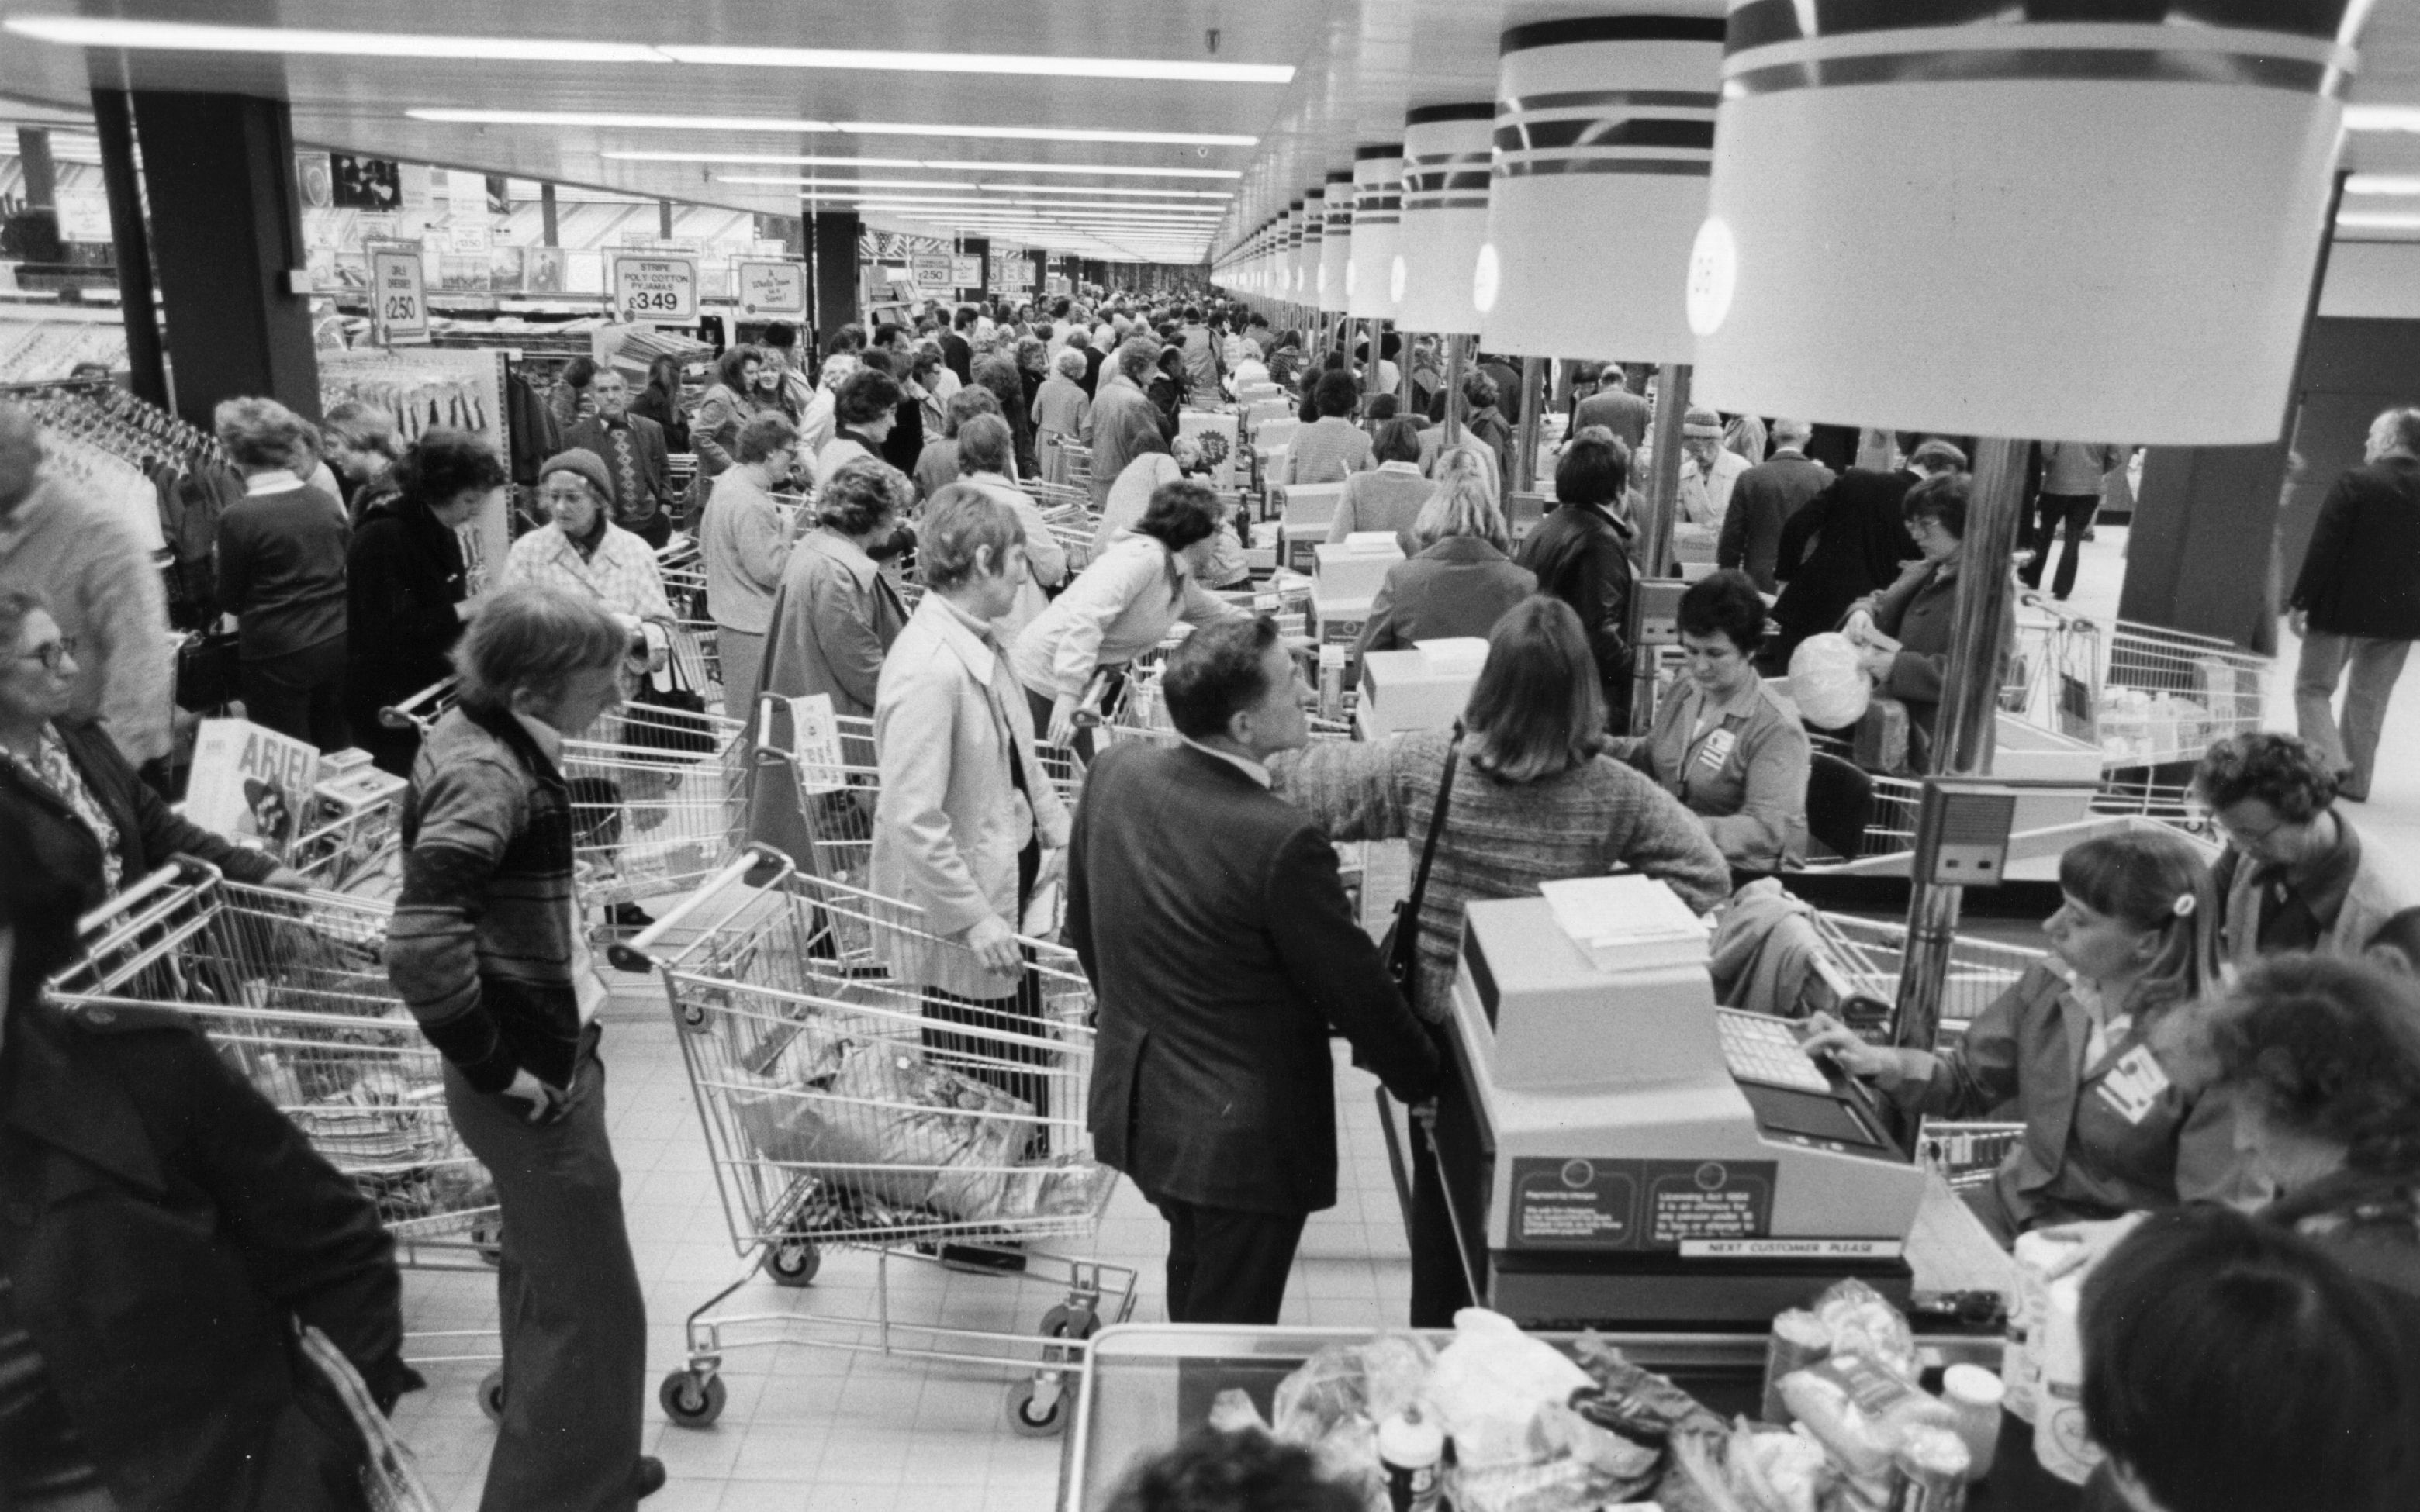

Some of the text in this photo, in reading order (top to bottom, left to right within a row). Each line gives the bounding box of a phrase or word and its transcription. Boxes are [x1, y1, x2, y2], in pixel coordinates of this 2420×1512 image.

[652, 274, 688, 283] COTTON
[631, 282, 673, 291] PYJAMAS
[1709, 1244, 1872, 1253] NEXT CUSTOMER PLEASE
